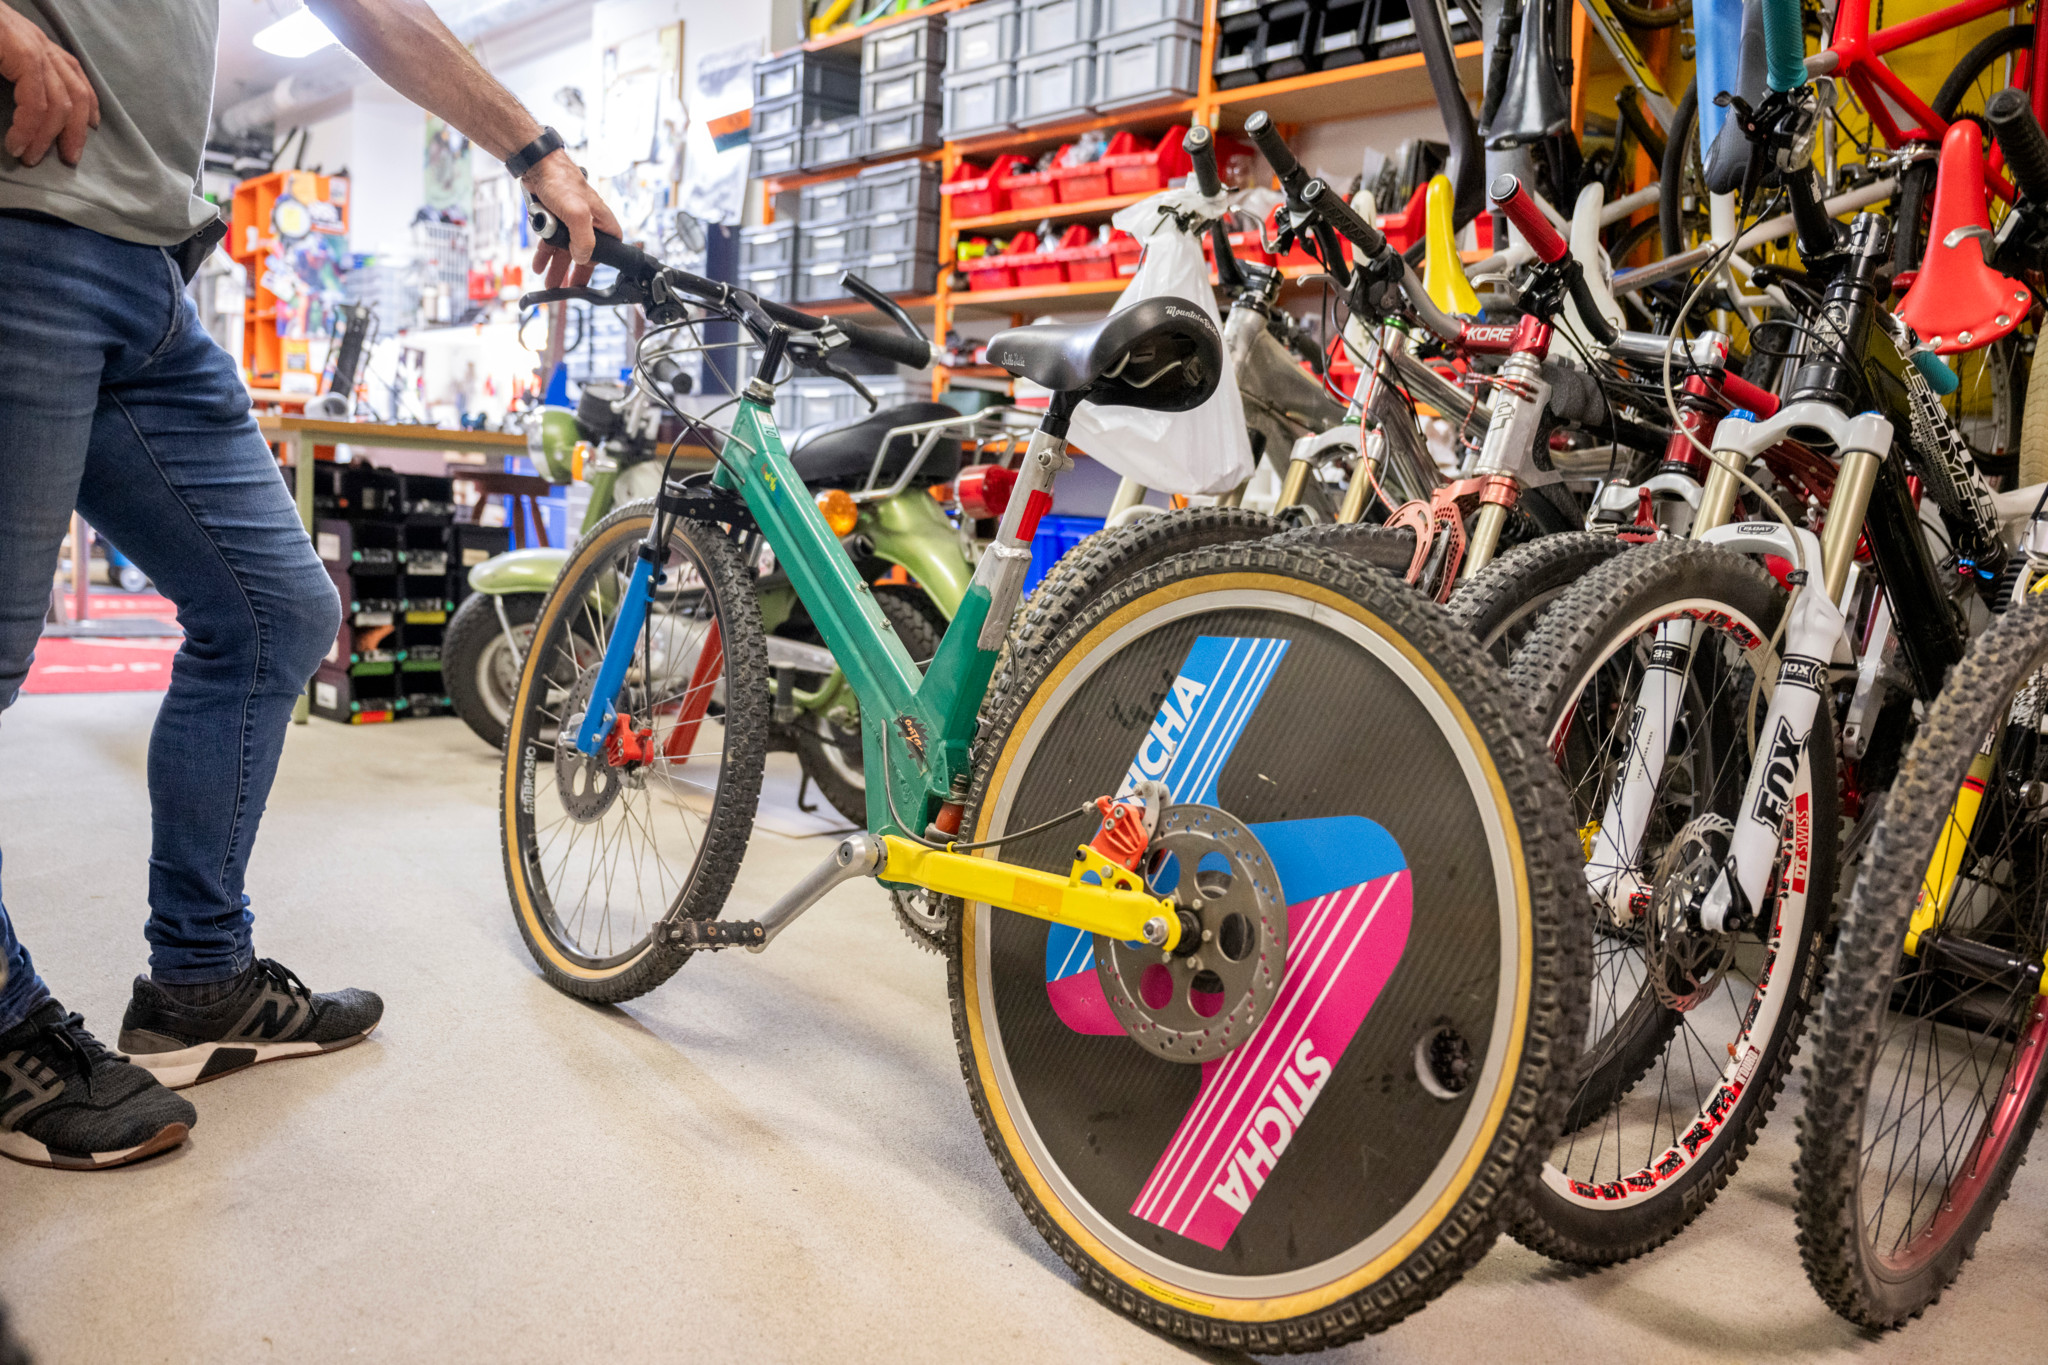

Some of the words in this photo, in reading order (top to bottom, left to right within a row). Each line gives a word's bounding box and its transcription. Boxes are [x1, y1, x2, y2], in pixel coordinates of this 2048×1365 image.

[1466, 327, 1514, 342] KORE
[1742, 525, 1771, 533] FLOAT
[1653, 649, 1673, 660] 32
[1112, 674, 1207, 808] TICHA
[523, 746, 537, 814] AMBROSIO
[1751, 715, 1812, 840] FOX
[1796, 810, 1809, 853] SWISS
[1793, 855, 1807, 880] DT
[1212, 1038, 1332, 1216] STICHA
[1682, 1139, 1738, 1210] ROCK
